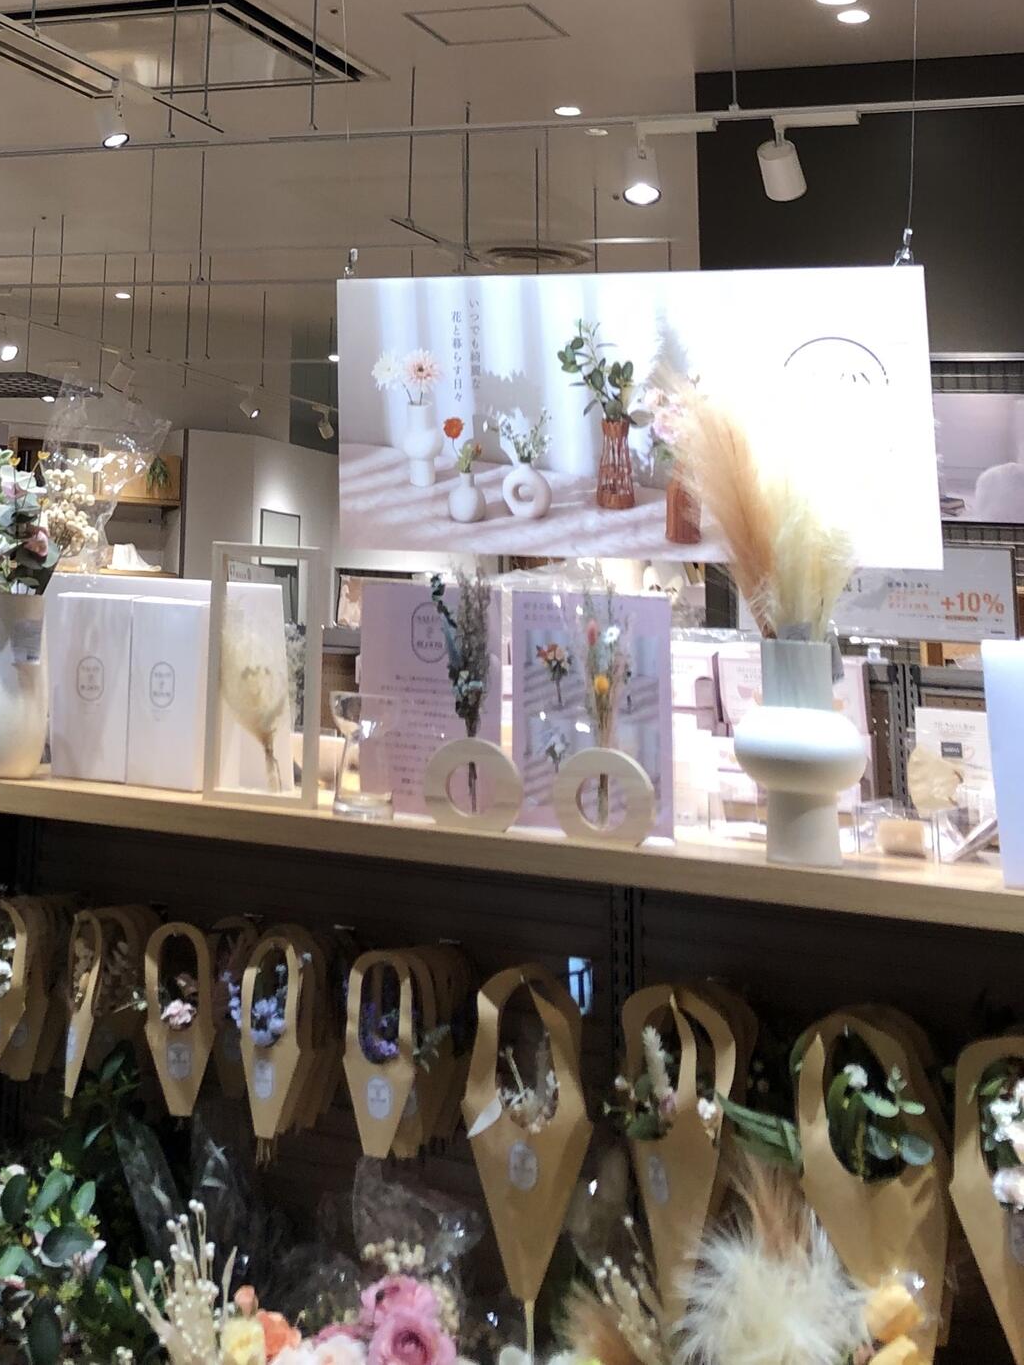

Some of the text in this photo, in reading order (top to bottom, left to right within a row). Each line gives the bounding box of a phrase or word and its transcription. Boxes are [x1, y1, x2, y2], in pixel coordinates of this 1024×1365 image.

[451, 310, 463, 403] 花と暮らす日々
[469, 297, 480, 390] いつでも綺麗な
[941, 590, 1006, 615] +10%
